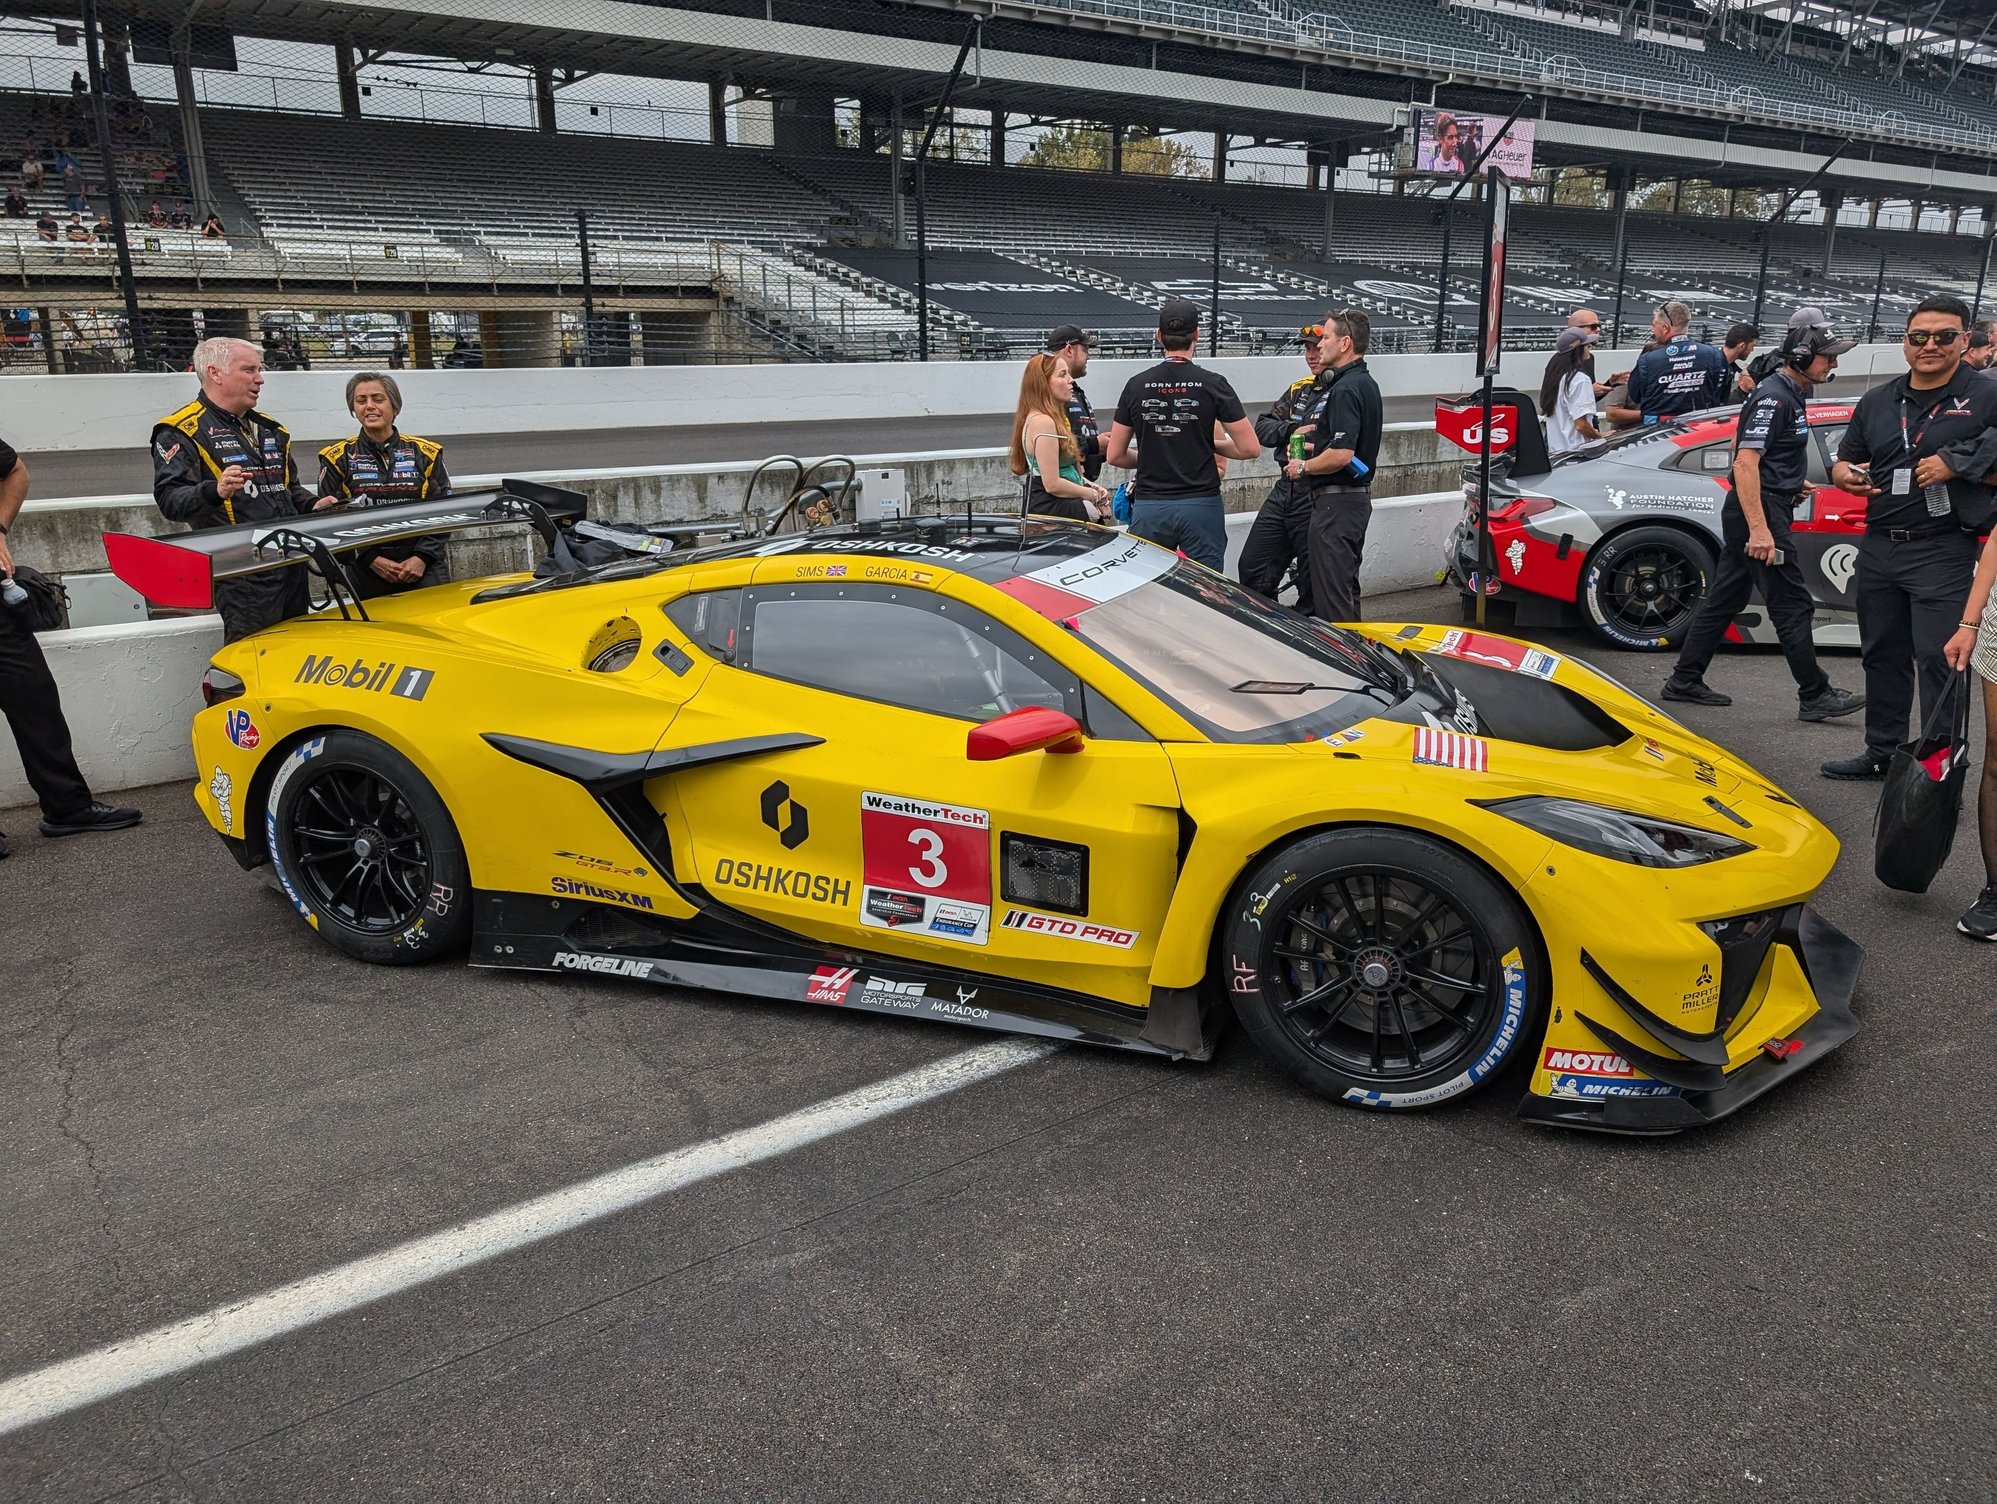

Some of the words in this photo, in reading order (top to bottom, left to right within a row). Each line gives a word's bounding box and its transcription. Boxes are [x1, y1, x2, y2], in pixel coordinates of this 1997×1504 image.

[1658, 370, 1707, 384] QUARTZ
[1814, 410, 1849, 418] VERHAGEN
[1630, 500, 1714, 509] FOUNDATION
[1668, 495, 1714, 503] HATCHER
[811, 540, 976, 563] OSHKOSH
[795, 566, 824, 577] SIMS
[865, 566, 908, 580] GARCIA
[1602, 625, 1649, 647] MICHELIN
[294, 655, 396, 693] Mobil
[403, 670, 422, 697] 1
[227, 709, 251, 747] VP
[551, 849, 614, 866] Z06
[907, 828, 948, 888] 3
[714, 858, 852, 907] OSHKOSH
[551, 876, 654, 909] SiriusXM
[1027, 916, 1078, 935] GTD
[1080, 926, 1133, 945] PRO
[551, 951, 655, 979] FORGELINE
[1231, 953, 1260, 993] RF
[862, 990, 922, 1002] MOTORSPORTS
[1683, 984, 1720, 1001] PRATT
[860, 996, 920, 1010] GATEWAY
[1681, 993, 1719, 1010] MILLER
[931, 1002, 990, 1020] MATADOR
[1474, 988, 1523, 1077] MICHELIN
[1548, 1051, 1631, 1072] MOTUL
[1438, 1081, 1465, 1097] PILOT
[1582, 1084, 1673, 1096] MICHELIN
[1400, 1093, 1436, 1104] SPORT
